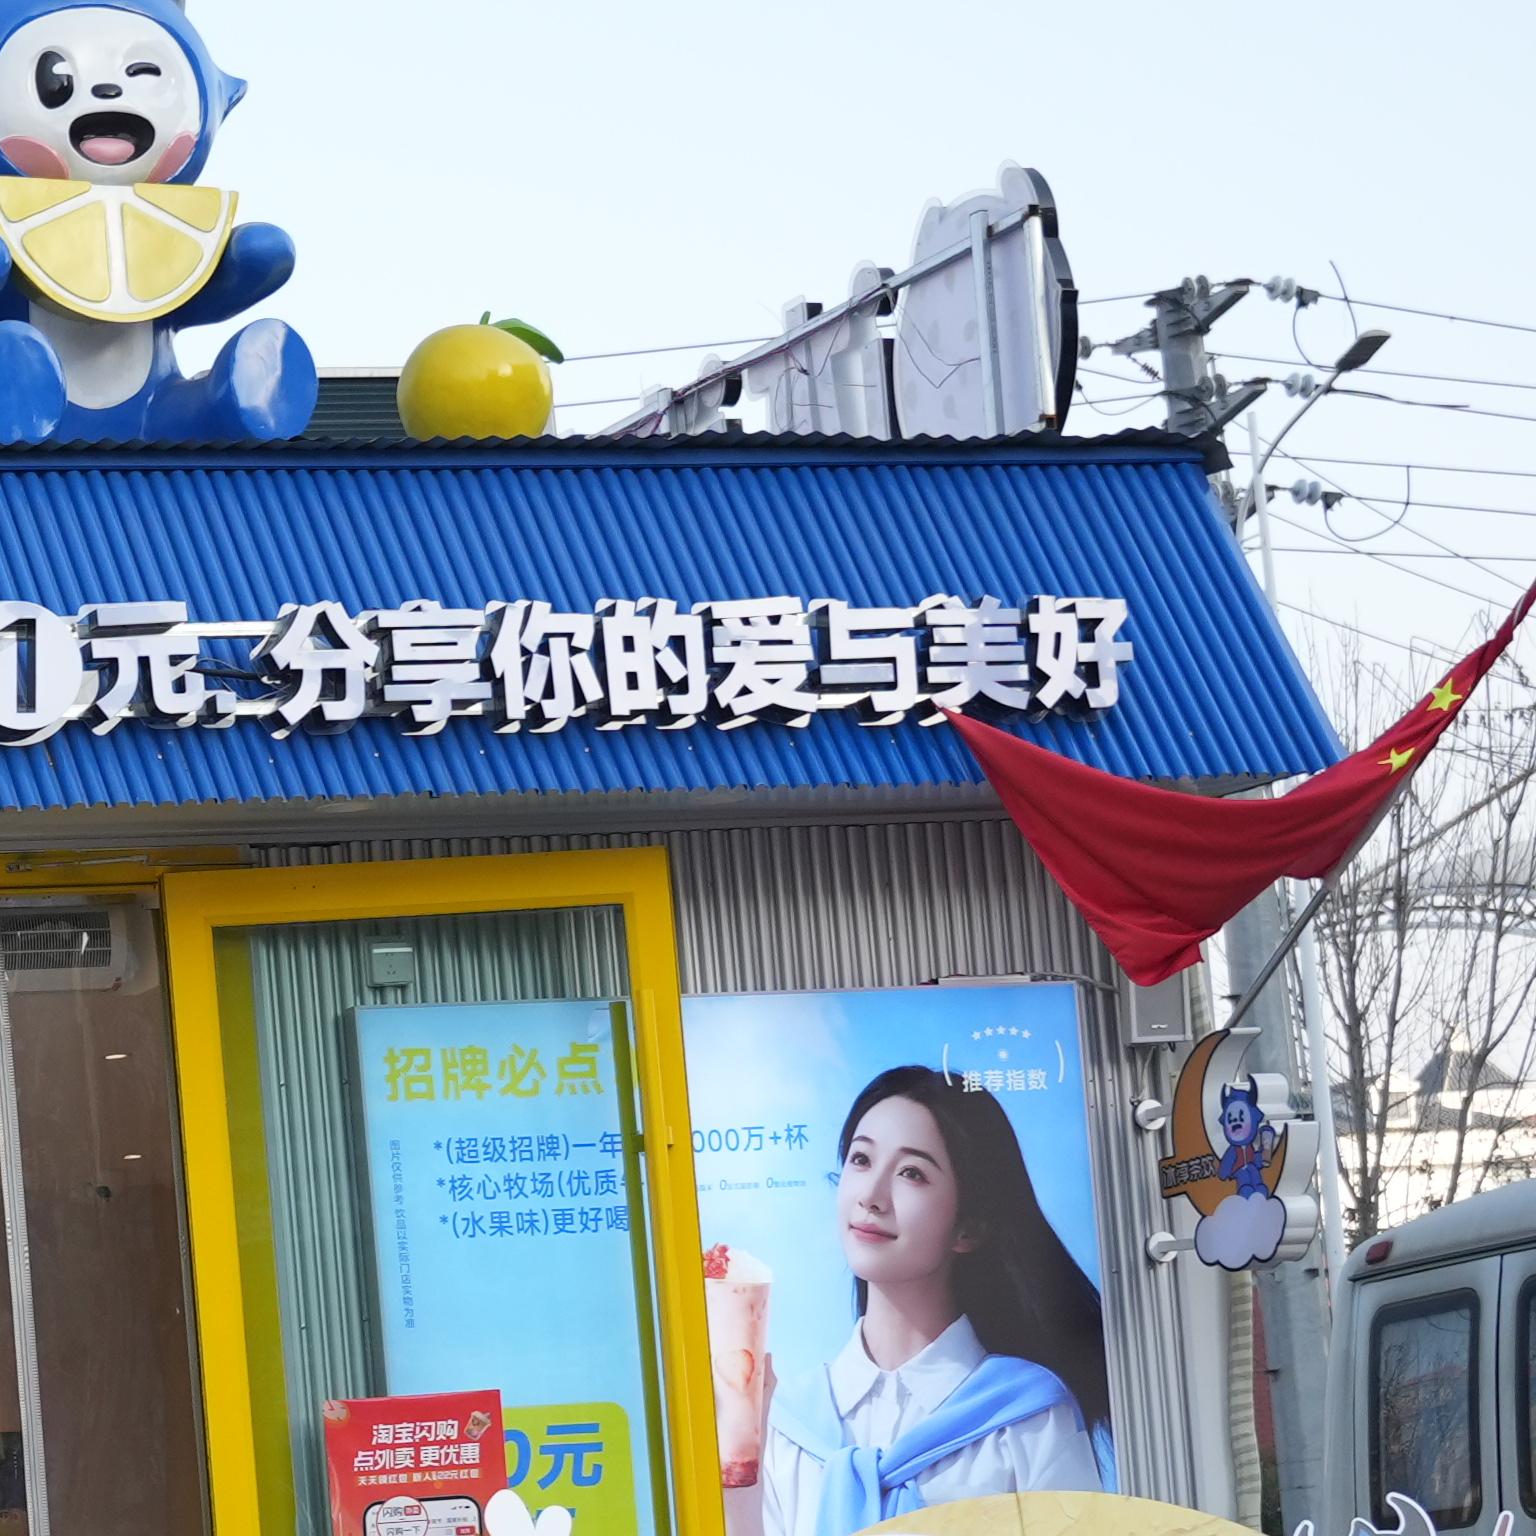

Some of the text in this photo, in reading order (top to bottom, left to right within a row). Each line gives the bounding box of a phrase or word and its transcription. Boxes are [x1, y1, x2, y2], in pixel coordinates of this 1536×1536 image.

[383, 1041, 601, 1103] 招牌必点
[962, 1069, 1047, 1093] 推荐指数
[436, 1168, 628, 1202] 核心牧场(优质
[372, 1419, 458, 1445] 淘宝闪购
[354, 1443, 480, 1471] 点外卖 更优惠
